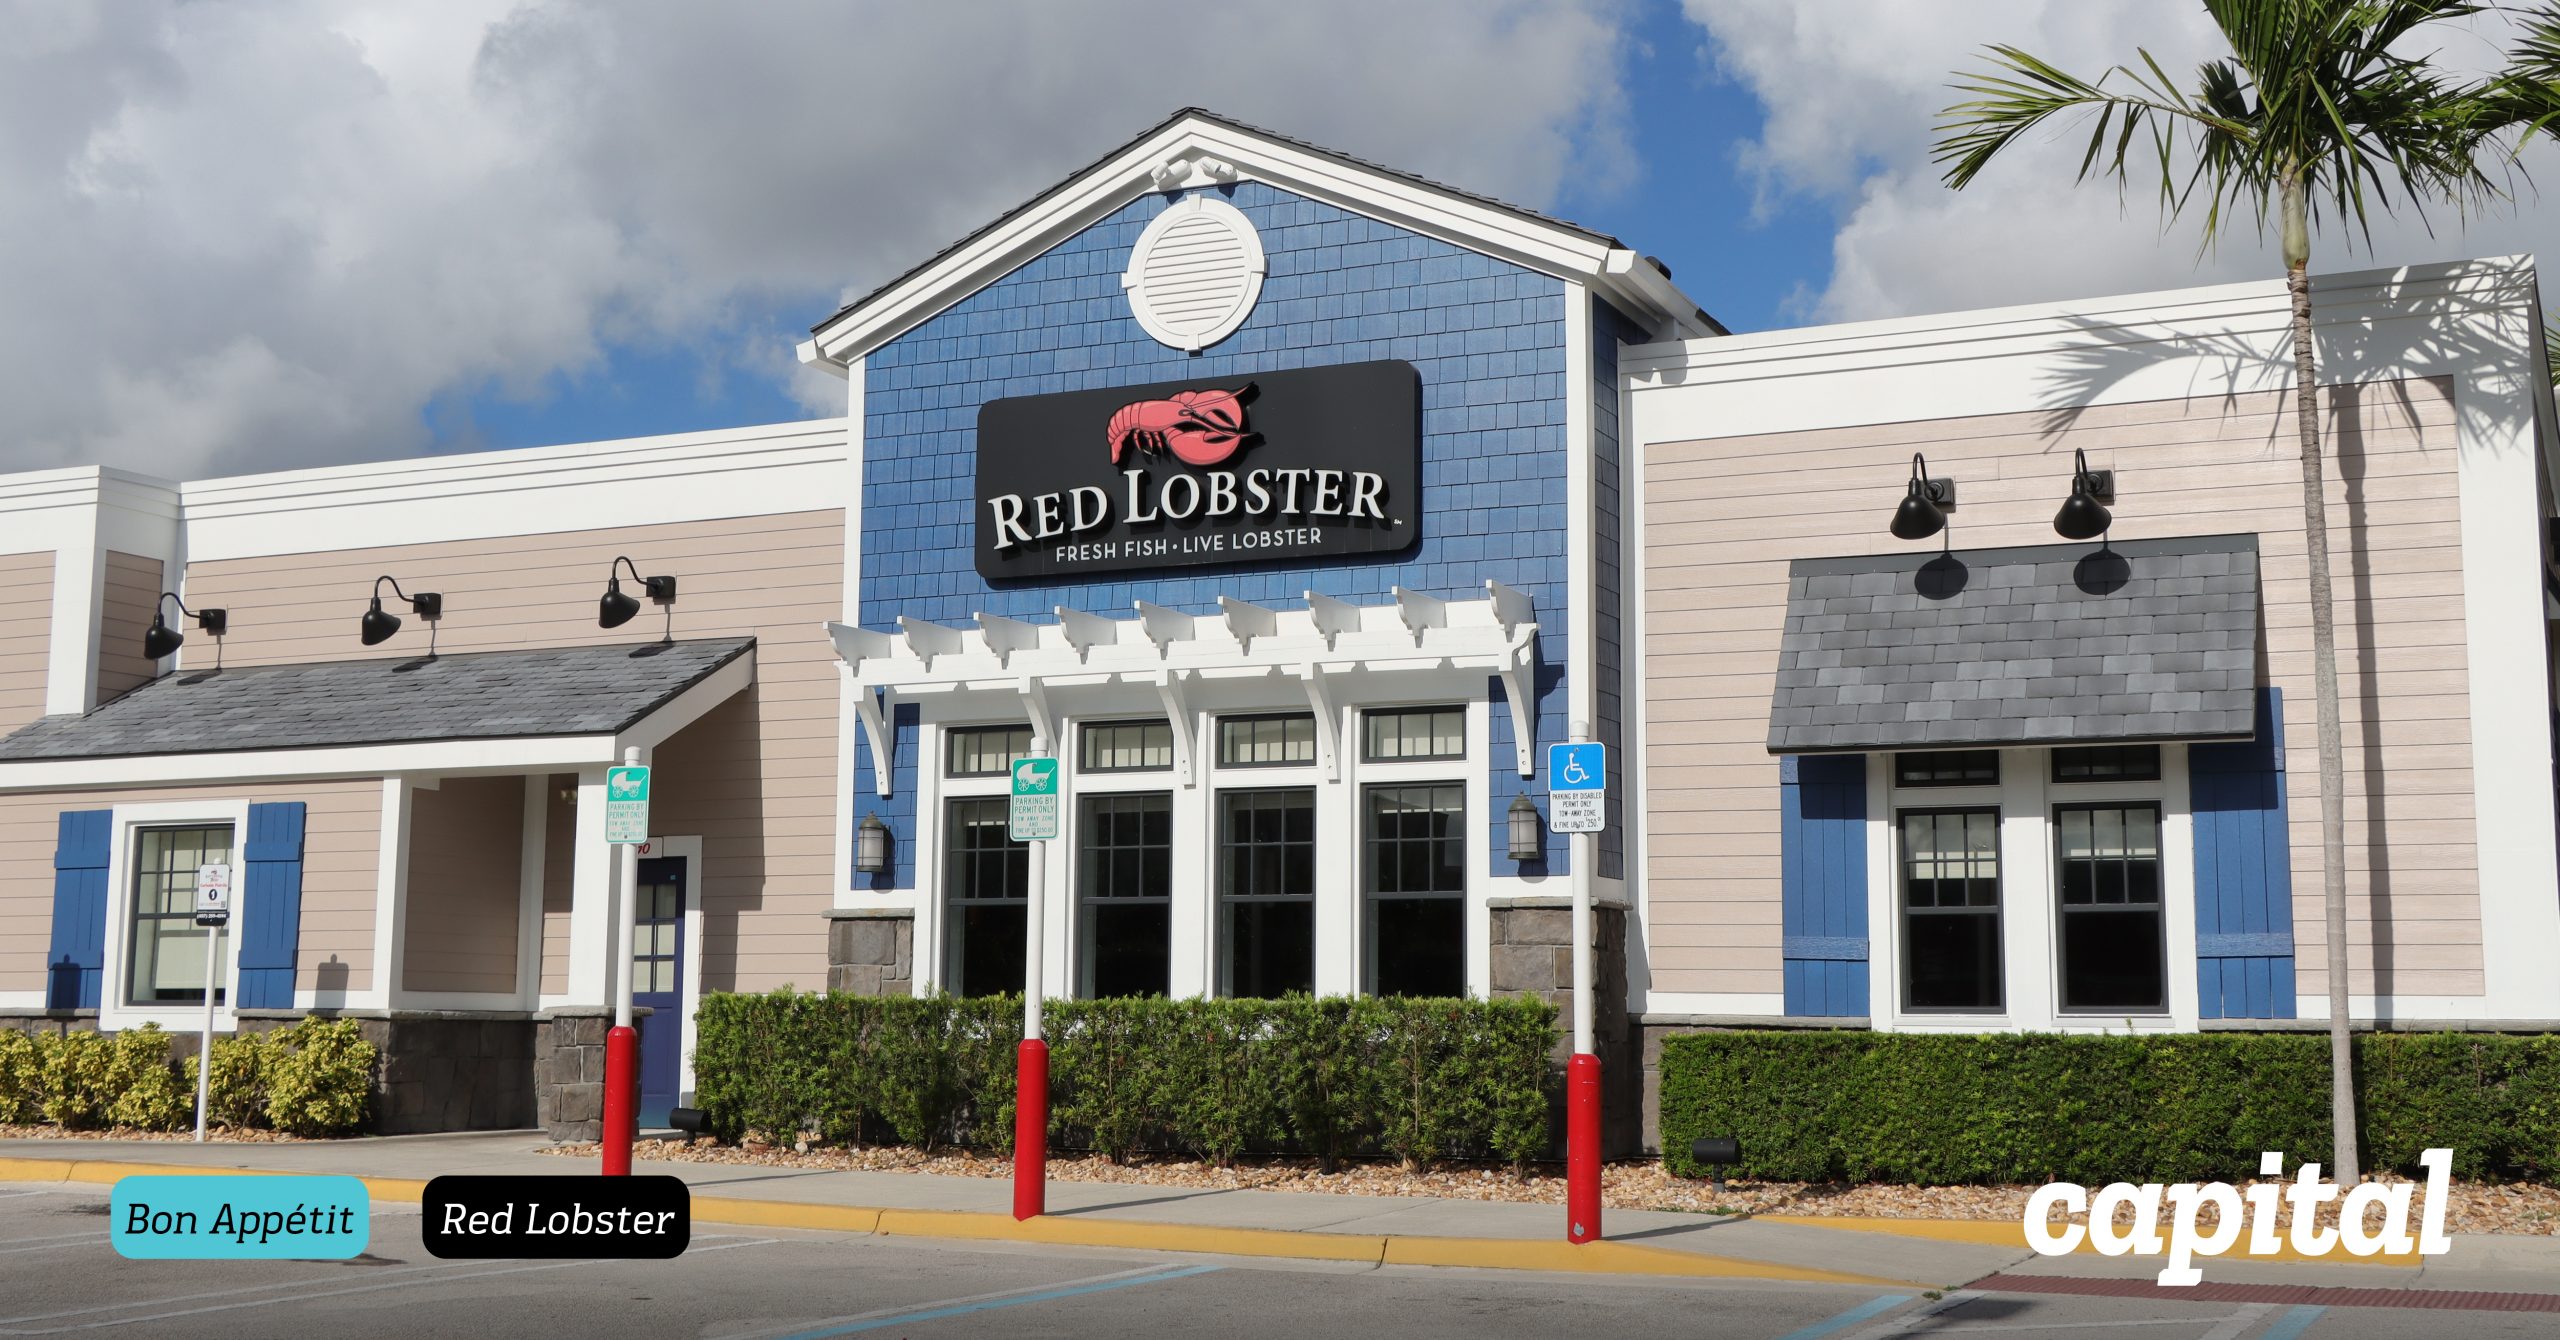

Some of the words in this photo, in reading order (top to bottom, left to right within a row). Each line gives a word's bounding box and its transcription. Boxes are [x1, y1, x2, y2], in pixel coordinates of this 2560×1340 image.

[988, 485, 1107, 550] RED
[1122, 467, 1385, 524] LOBSTER
[1056, 543, 1116, 563] FRESH
[1125, 539, 1167, 558] FISH
[1183, 534, 1224, 553] LIVE
[1232, 527, 1323, 550] LOBSTER
[1015, 796, 1043, 805] PARKING
[1045, 796, 1053, 804] BY
[1580, 792, 1602, 800] DISABLED
[1014, 806, 1037, 814] PERMIT
[1039, 805, 1054, 813] ONLY
